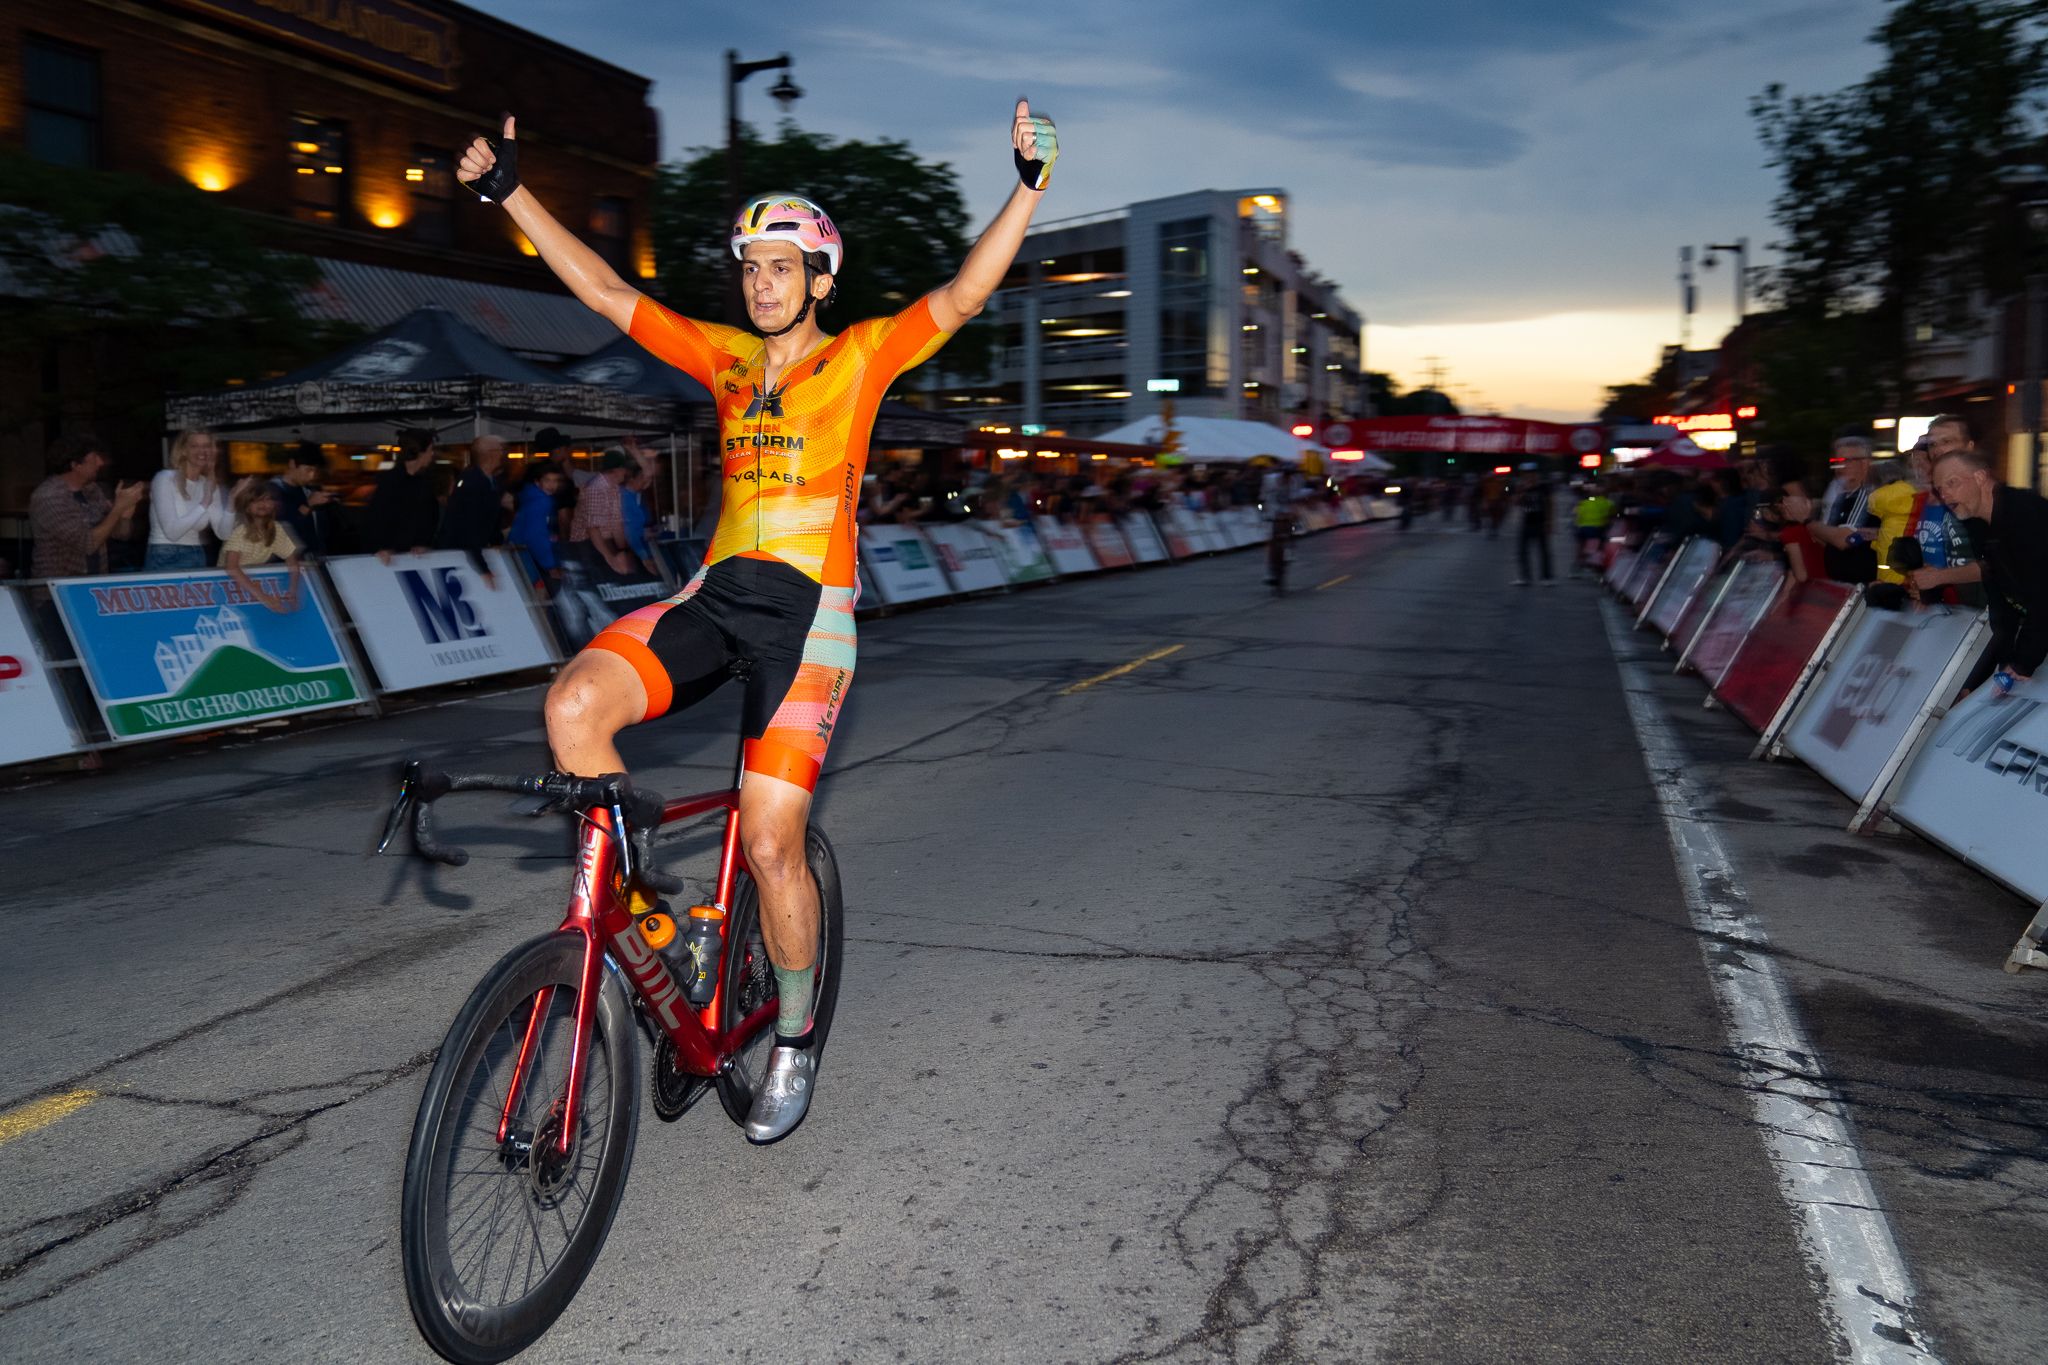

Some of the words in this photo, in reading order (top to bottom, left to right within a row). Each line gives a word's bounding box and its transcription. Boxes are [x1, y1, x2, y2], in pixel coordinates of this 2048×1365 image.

[726, 435, 805, 451] STORM
[742, 424, 780, 433] REGN
[729, 451, 751, 460] CLEAN
[845, 462, 855, 500] HGR
[89, 580, 217, 616] MURRAY
[430, 645, 498, 668] INSURANCE
[139, 679, 331, 727] NEIGHBORHOOD
[827, 669, 846, 721] STORM
